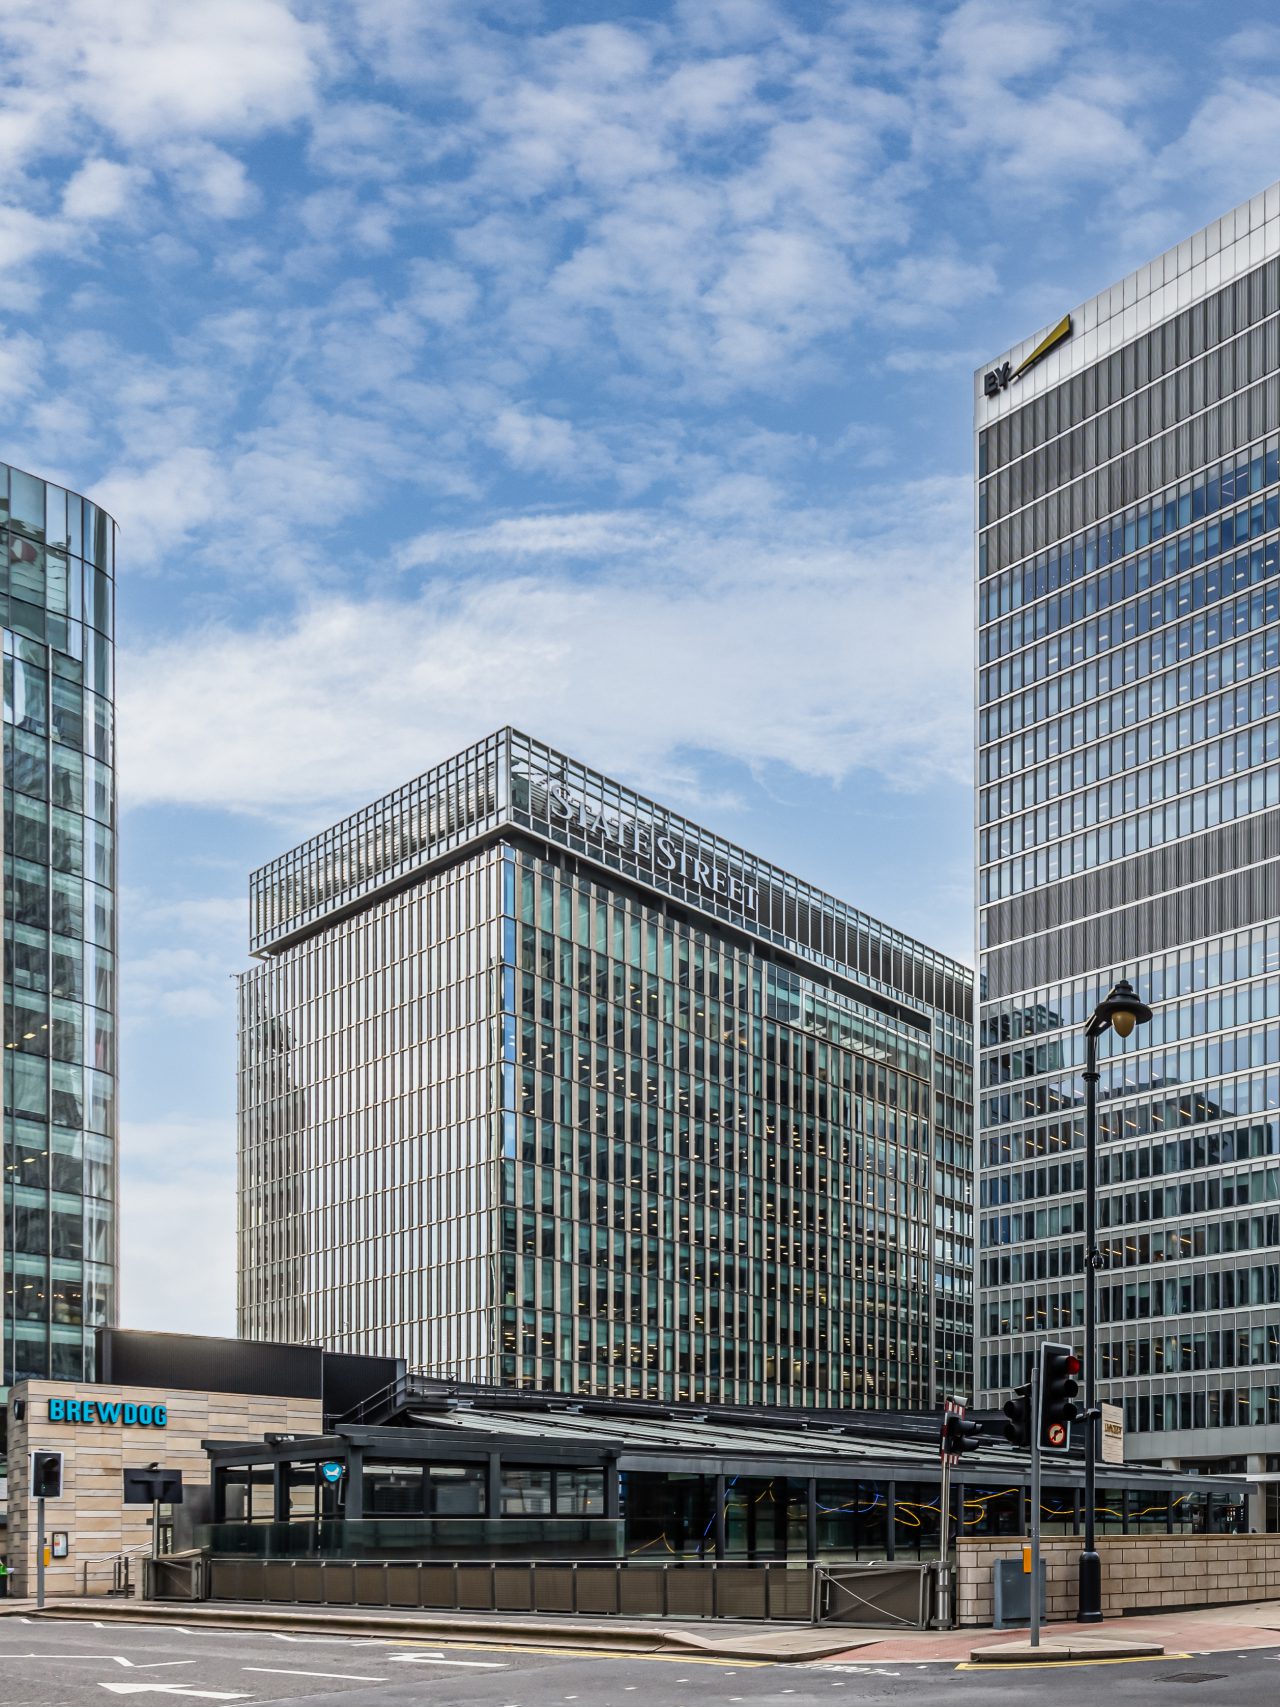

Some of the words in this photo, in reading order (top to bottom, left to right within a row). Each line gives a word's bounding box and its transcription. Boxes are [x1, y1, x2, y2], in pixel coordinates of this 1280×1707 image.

[984, 361, 1010, 396] EY
[549, 784, 651, 859] STATE
[656, 836, 760, 910] STREET
[48, 1398, 168, 1427] BREWDOG
